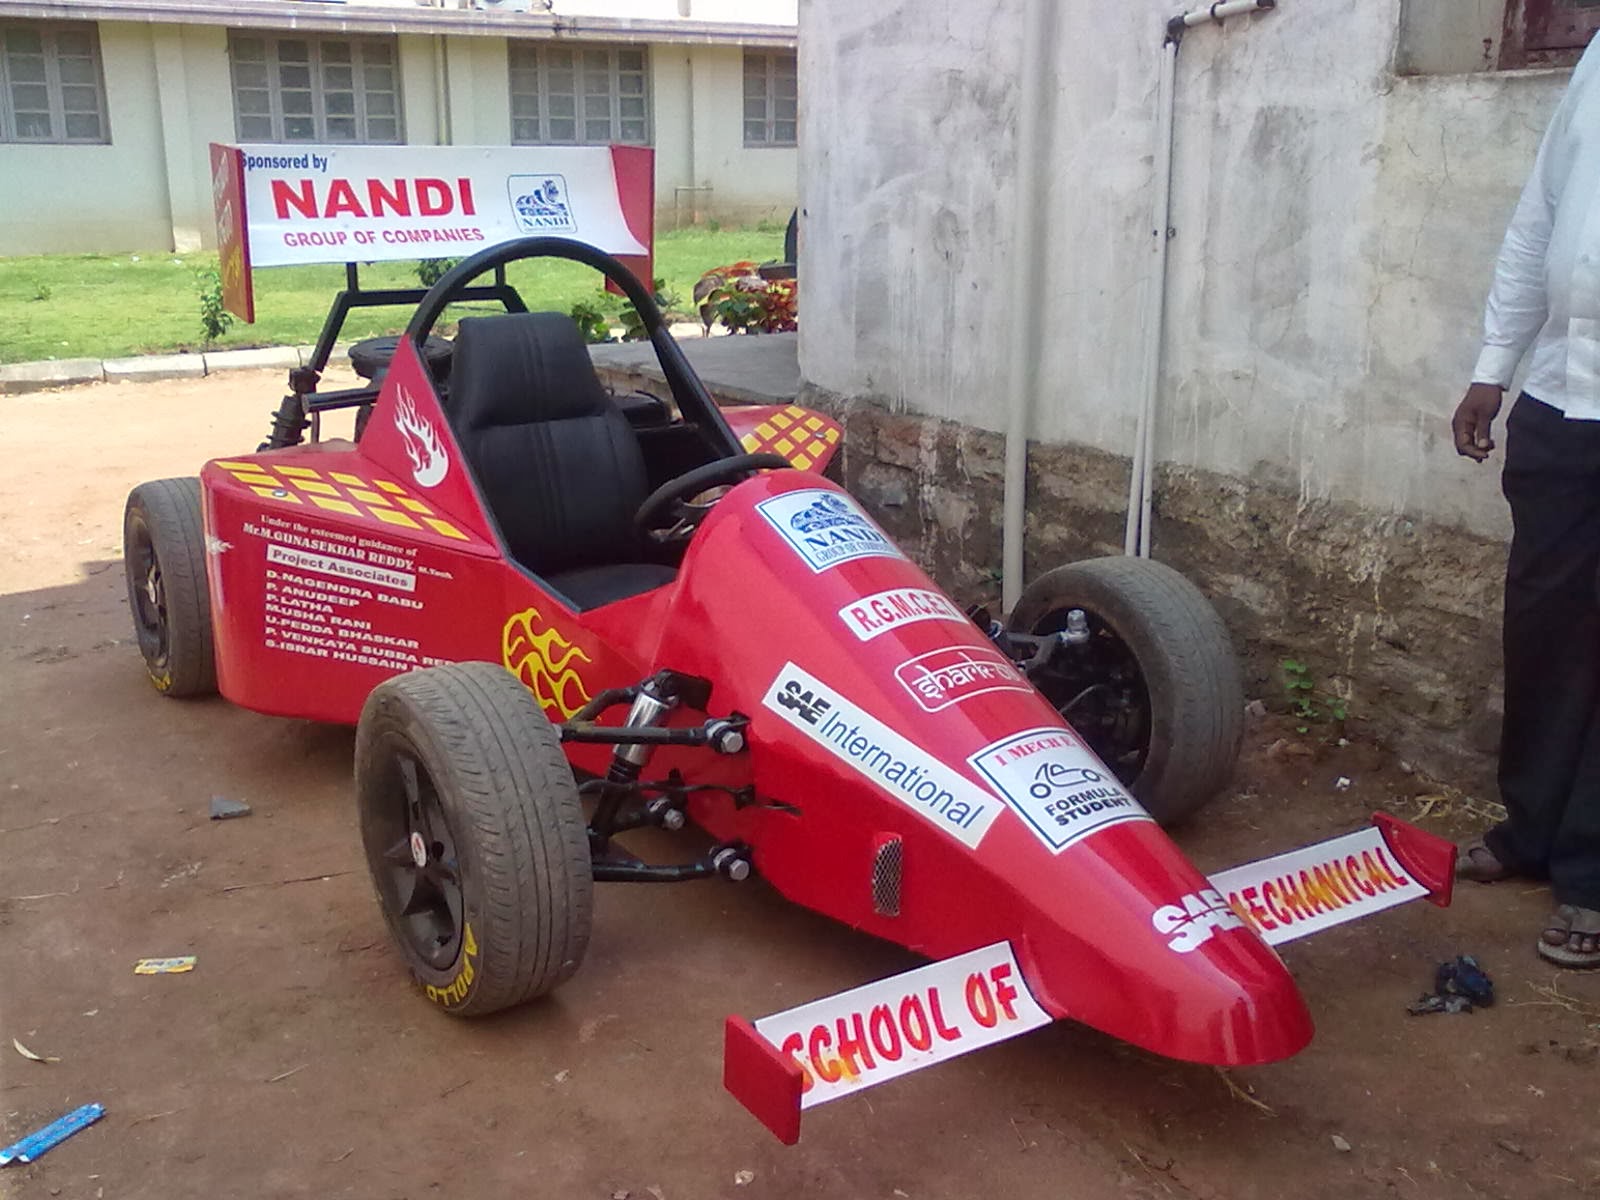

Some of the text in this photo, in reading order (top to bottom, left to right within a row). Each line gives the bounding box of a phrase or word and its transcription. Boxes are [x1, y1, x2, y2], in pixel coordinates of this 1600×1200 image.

[241, 152, 328, 173] Sponsored by
[271, 177, 476, 219] NANDI
[522, 217, 569, 226] NANDI
[283, 227, 486, 247] GROUP OF COMPANIES
[261, 514, 419, 557] Under the esteemed guidance of
[803, 528, 888, 551] NANDI
[273, 549, 409, 587] Project Associates
[266, 569, 424, 609] D.NAGENDRA BABU
[282, 585, 360, 607] ANUDEEP
[330, 615, 372, 630] RANI
[281, 630, 356, 652] VENKATA
[361, 645, 419, 663] SUBBA
[338, 629, 419, 649] BHASKAR
[333, 650, 409, 670] HUSSAIN
[777, 680, 984, 829] SAE International
[1044, 787, 1124, 817] FORMULA
[1055, 797, 1133, 827] STUDENT
[1152, 889, 1247, 953] SAE
[781, 962, 1018, 1094] SCHOOL OF
